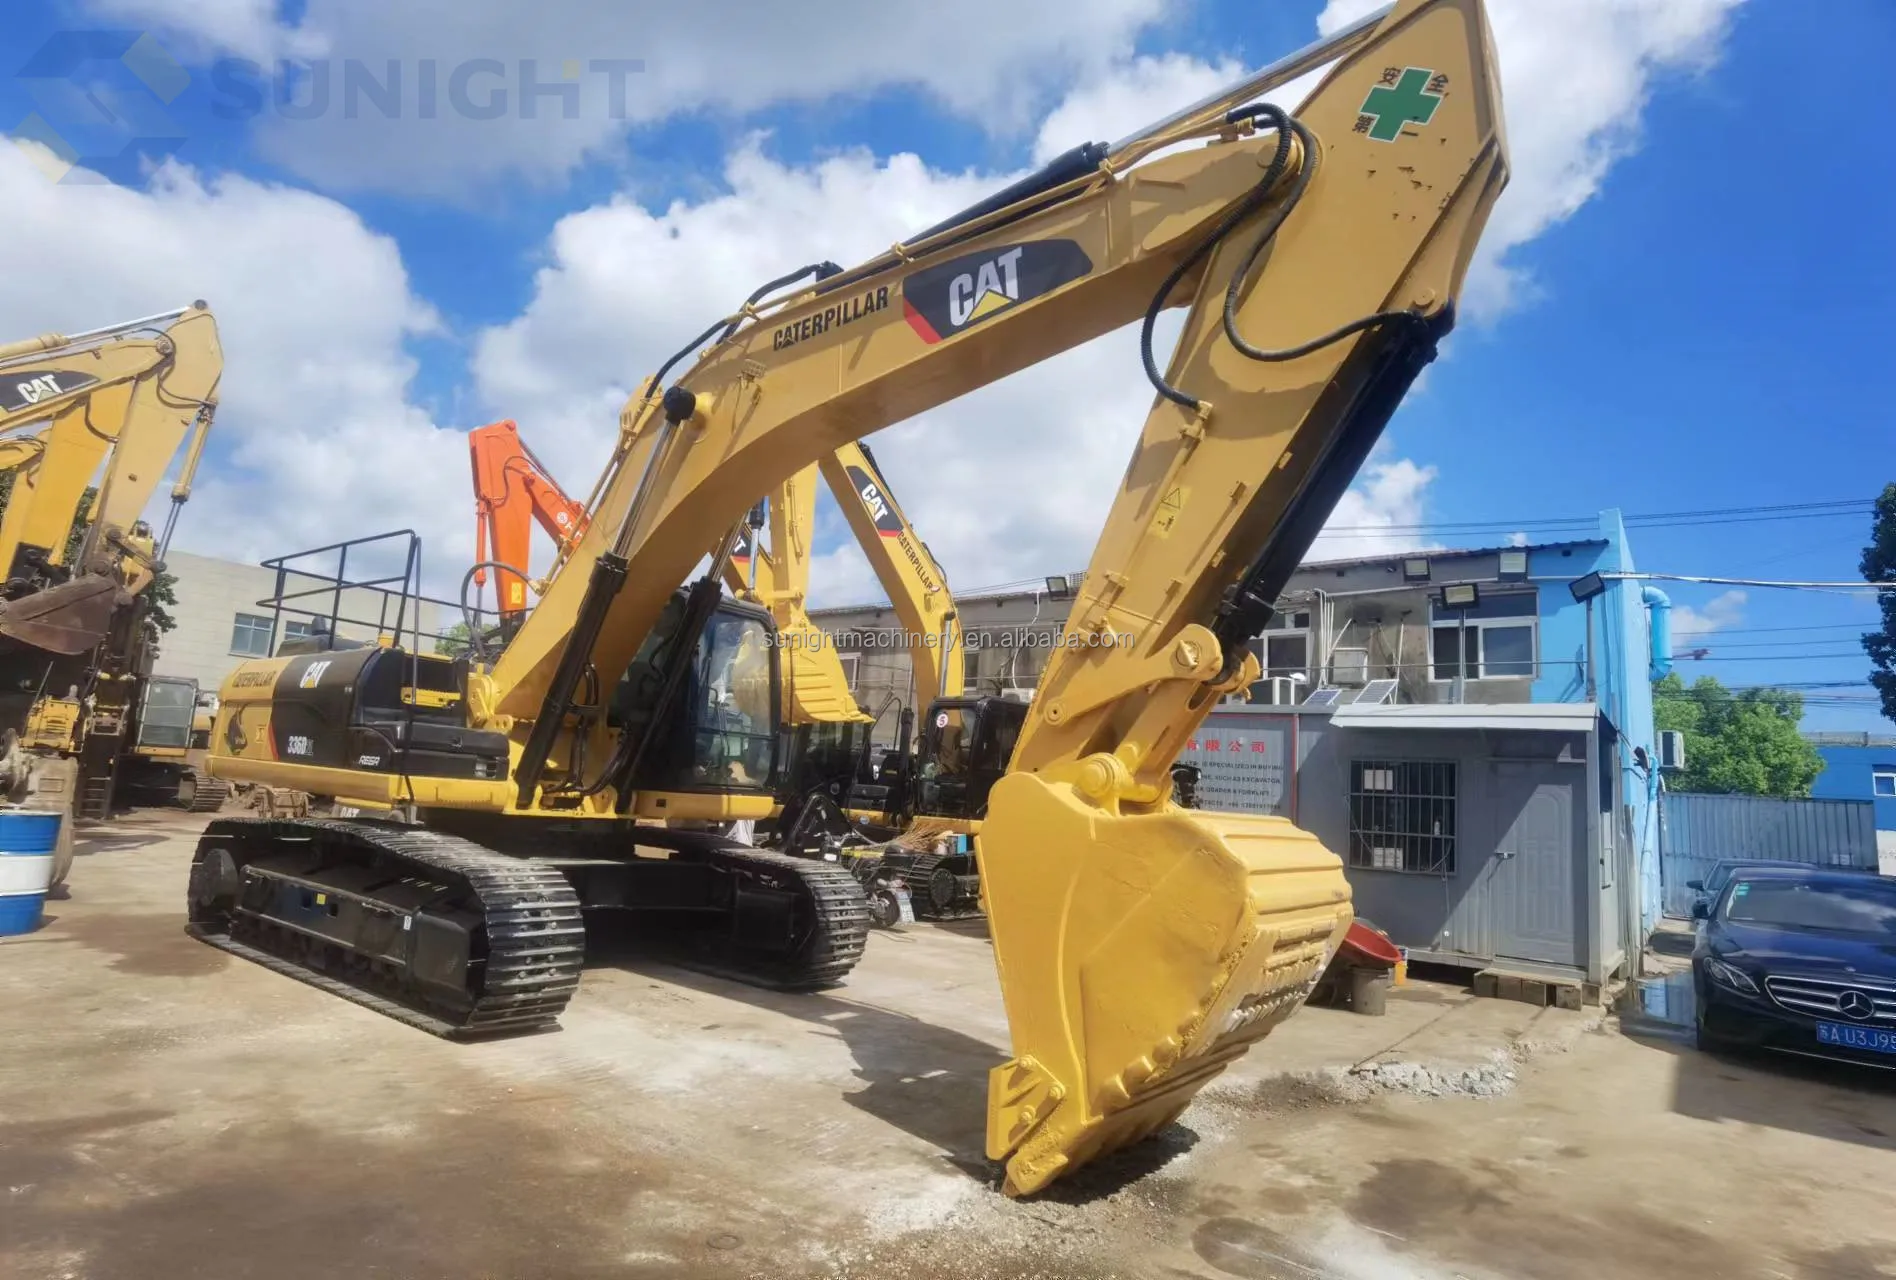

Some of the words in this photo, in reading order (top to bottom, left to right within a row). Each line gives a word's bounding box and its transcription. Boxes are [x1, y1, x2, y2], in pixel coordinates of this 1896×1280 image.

[949, 246, 1023, 327] CAT
[773, 285, 889, 351] CATERPILLAR
[17, 374, 64, 403] CAT
[861, 483, 889, 522] CAT
[896, 531, 934, 590] CATERPILLAR
[299, 660, 333, 689] CAT
